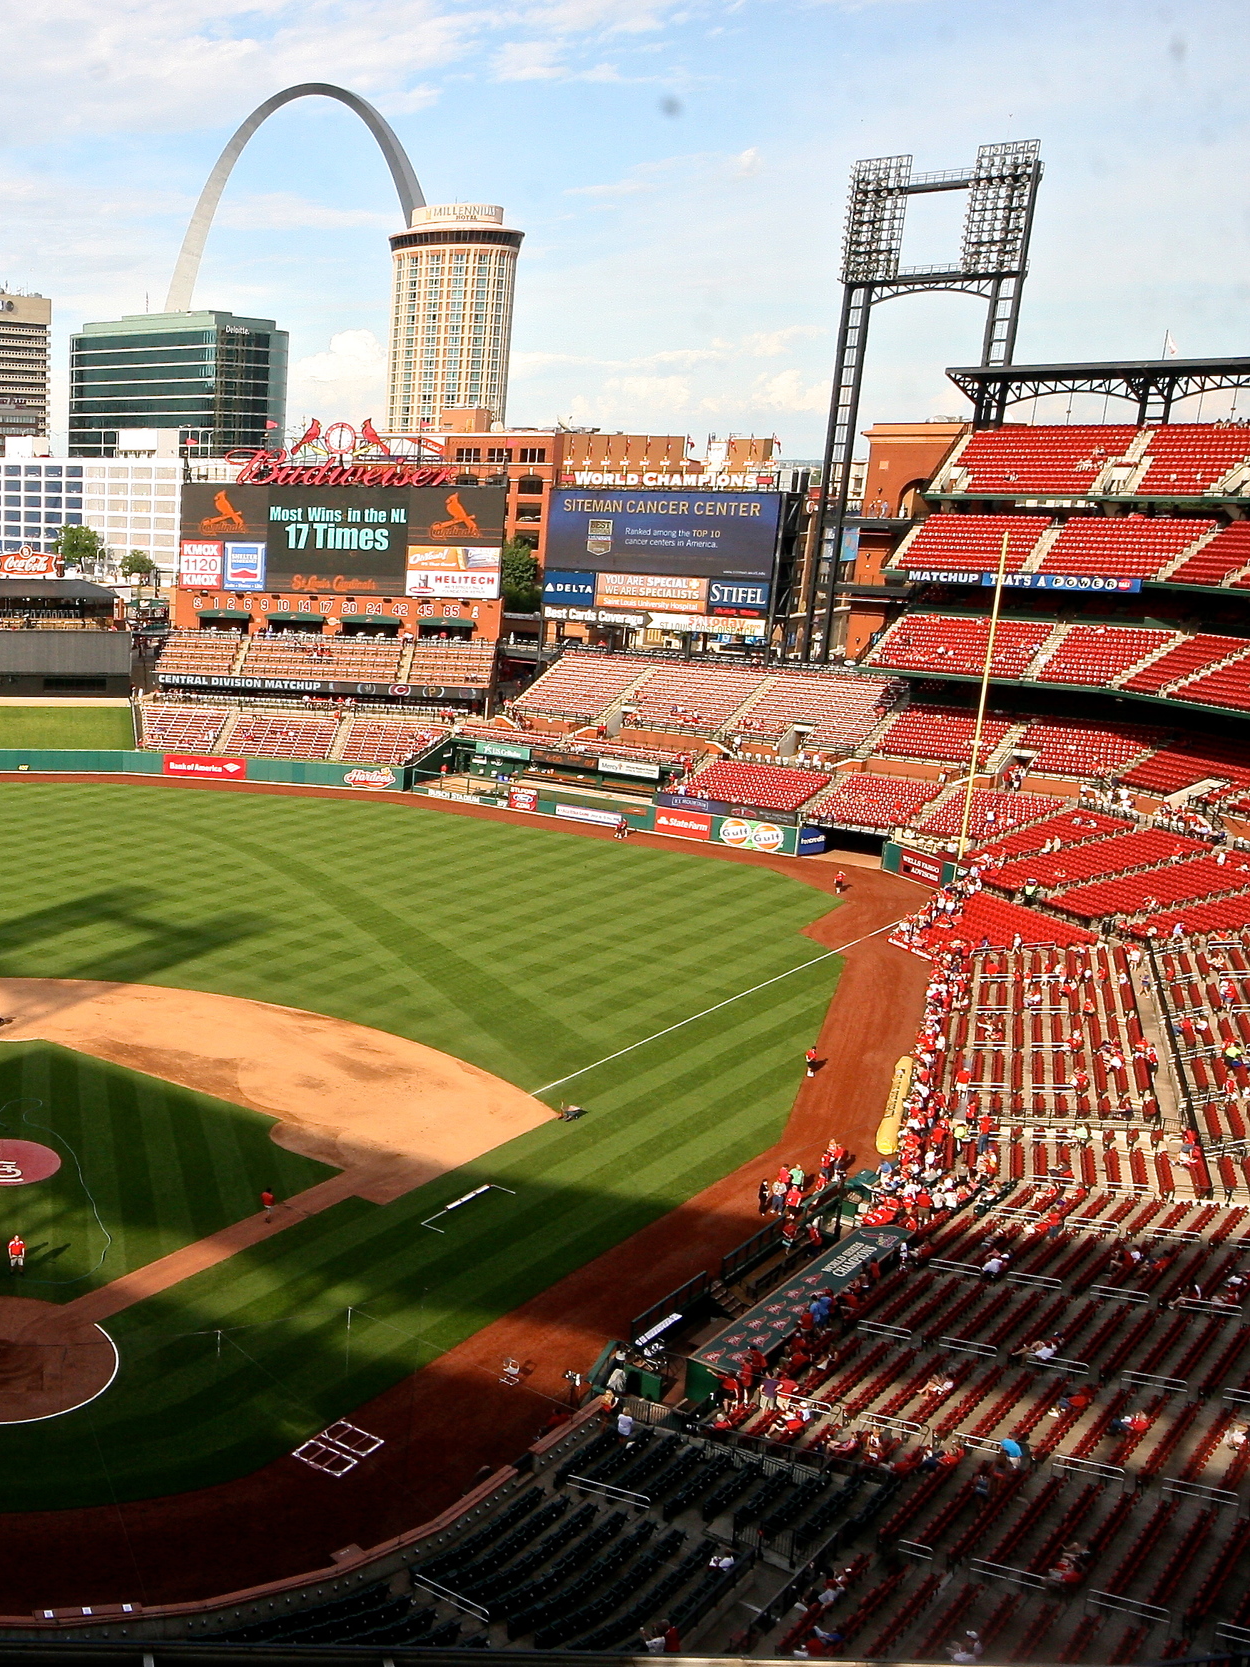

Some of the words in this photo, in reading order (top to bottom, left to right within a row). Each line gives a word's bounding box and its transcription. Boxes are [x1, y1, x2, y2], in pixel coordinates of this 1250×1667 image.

[433, 206, 497, 217] MILLENNIUM
[225, 448, 460, 488] Budweiser
[573, 471, 639, 486] WORLD
[642, 472, 758, 488] CHAMPIONS
[269, 505, 303, 523] Most
[307, 506, 342, 523] Wins
[347, 507, 361, 523] in
[363, 507, 387, 523] the
[390, 508, 407, 524] NL
[563, 498, 623, 514] SITEMAN
[626, 499, 689, 515] CANCER
[693, 501, 761, 517] CENTER
[285, 523, 309, 550] 17
[313, 522, 390, 551] Times
[625, 527, 651, 537] Ranked
[652, 528, 677, 539] among
[678, 528, 691, 537] the
[692, 529, 708, 538] TOP
[710, 529, 720, 539] 10
[183, 543, 219, 556] KMOX
[625, 538, 648, 547] cancer
[649, 538, 675, 548] centers
[676, 539, 685, 548] in
[686, 538, 718, 549] America.
[3, 556, 49, 572] Coca-Cola
[184, 558, 218, 572] 1120
[182, 574, 218, 586] KMOX
[434, 575, 495, 585] HELITECH
[605, 574, 625, 585] YOU
[627, 575, 644, 586] ARE
[646, 576, 688, 589] SPECIAL
[908, 570, 979, 583] MATCHUP
[1036, 575, 1047, 587] A
[1052, 576, 1118, 591] POWER
[556, 583, 592, 594] DELTA
[605, 585, 618, 595] WE
[619, 586, 637, 596] ARE
[638, 587, 700, 600] SPECIALISTS
[710, 583, 766, 605] STIFEL
[227, 598, 236, 610] 2
[244, 598, 252, 611] 6
[260, 599, 269, 611] 9
[278, 599, 290, 612] 10
[298, 600, 311, 613] 14
[320, 601, 334, 613] 17
[341, 602, 357, 615] 20
[365, 602, 383, 615] 24
[391, 603, 409, 616] 42
[417, 604, 434, 617] 45
[443, 605, 460, 618] 85
[603, 597, 620, 606] Saint
[621, 598, 637, 607] Louis
[637, 600, 670, 611] University
[670, 602, 698, 612] Hospital
[544, 606, 567, 619] Best
[569, 609, 597, 622] Cards
[598, 610, 644, 627] Coverage
[672, 623, 693, 634] LOUIS
[158, 674, 208, 685] CENTRAL
[211, 676, 261, 688] DIVISION
[264, 679, 321, 691] MATCHUP
[169, 761, 187, 771] Bank
[186, 762, 194, 771] of
[194, 763, 223, 773] America
[601, 761, 618, 773] Mercy
[429, 788, 450, 799] BUSCH
[451, 792, 480, 804] STADIUM
[669, 817, 689, 829] State
[688, 821, 708, 832] Farm
[722, 827, 749, 838] Gulf
[753, 832, 781, 844] Gulf
[903, 854, 922, 867] WELLS
[921, 860, 940, 874] FARGO
[911, 866, 938, 882] ADVISORS
[821, 1254, 847, 1273] WORLD
[841, 1241, 865, 1258] SERIES
[832, 1244, 878, 1277] CHAMPIONS
